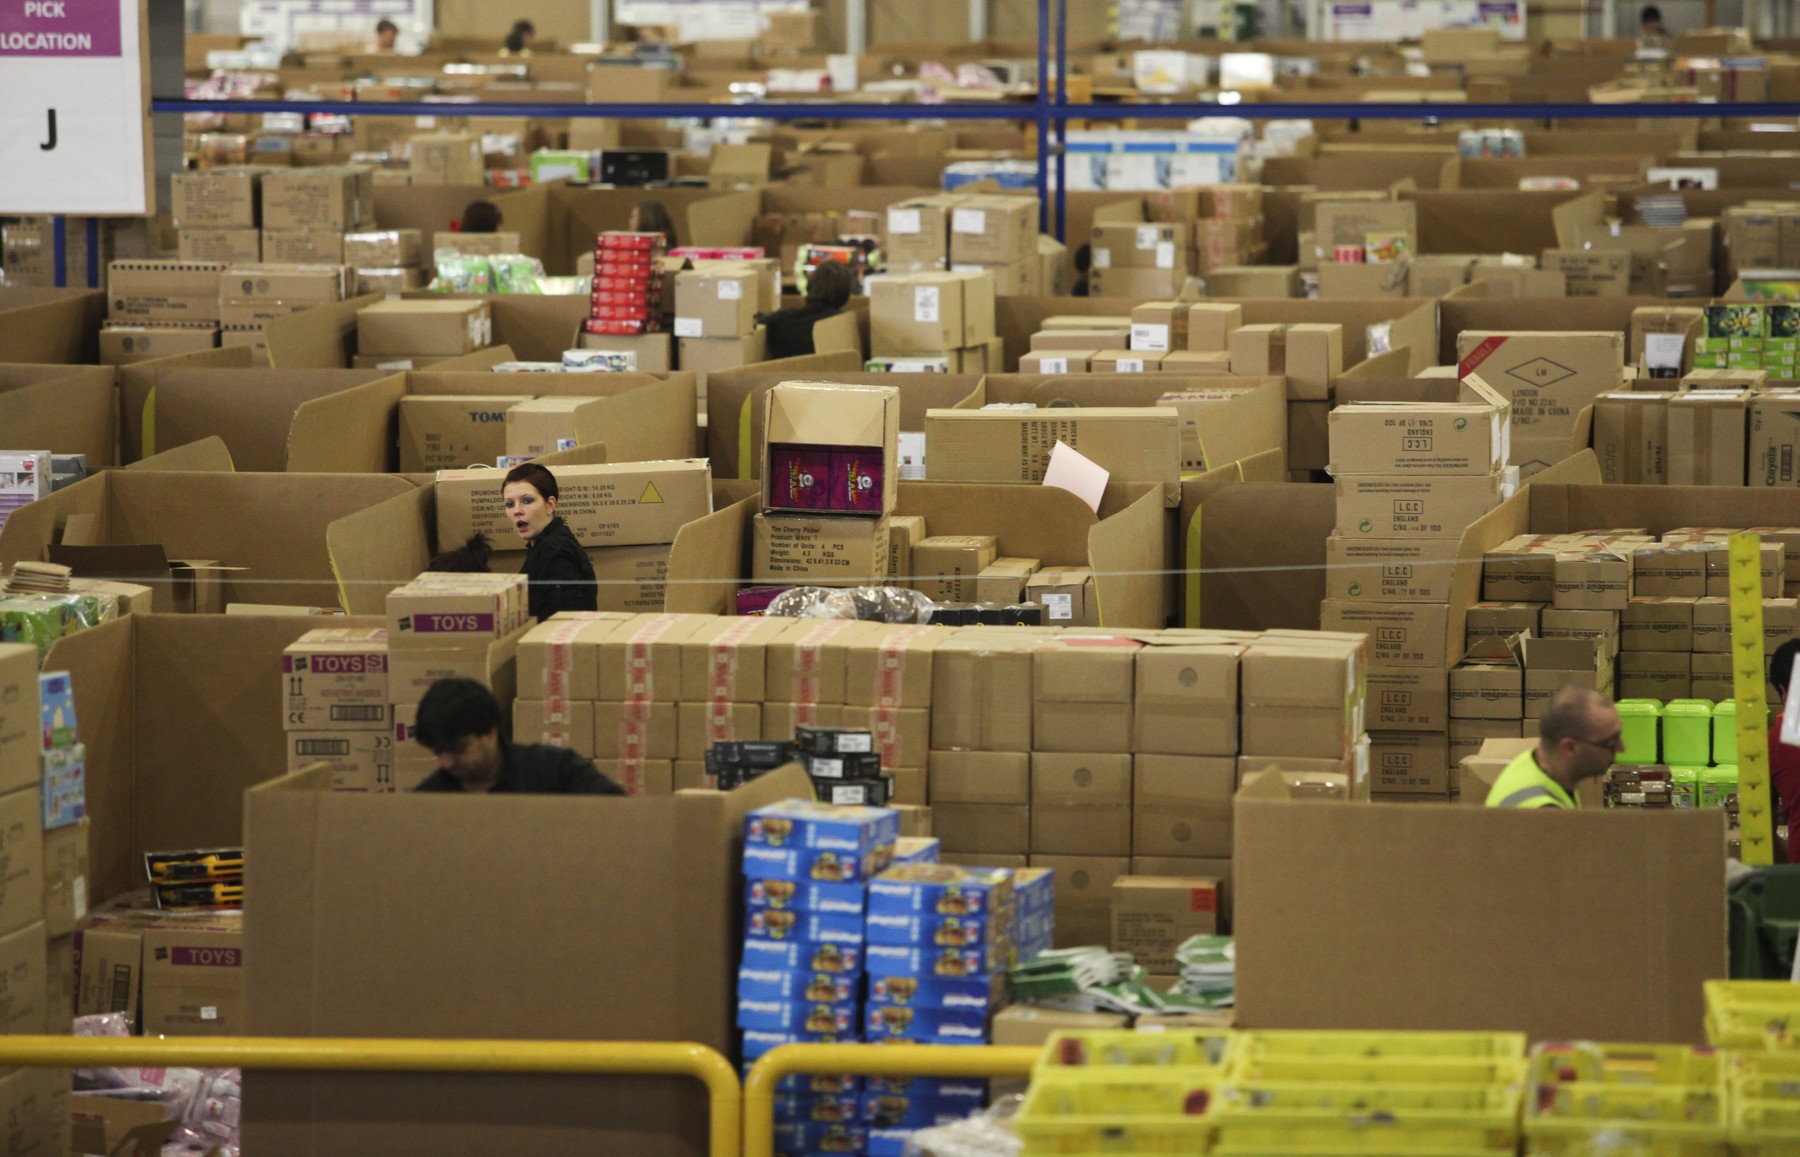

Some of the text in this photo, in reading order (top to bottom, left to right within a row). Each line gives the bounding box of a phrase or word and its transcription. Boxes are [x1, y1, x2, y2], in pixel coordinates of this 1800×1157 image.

[24, 0, 66, 18] PICK
[0, 32, 91, 50] LOCATION
[40, 109, 57, 151] J
[1512, 389, 1538, 397] LONDON
[469, 412, 506, 423] TOM
[1766, 445, 1777, 487] Crayola
[783, 526, 801, 534] Cherry
[430, 616, 478, 630] TOYS
[316, 657, 362, 671] TOYS
[189, 949, 236, 965] TOYS
